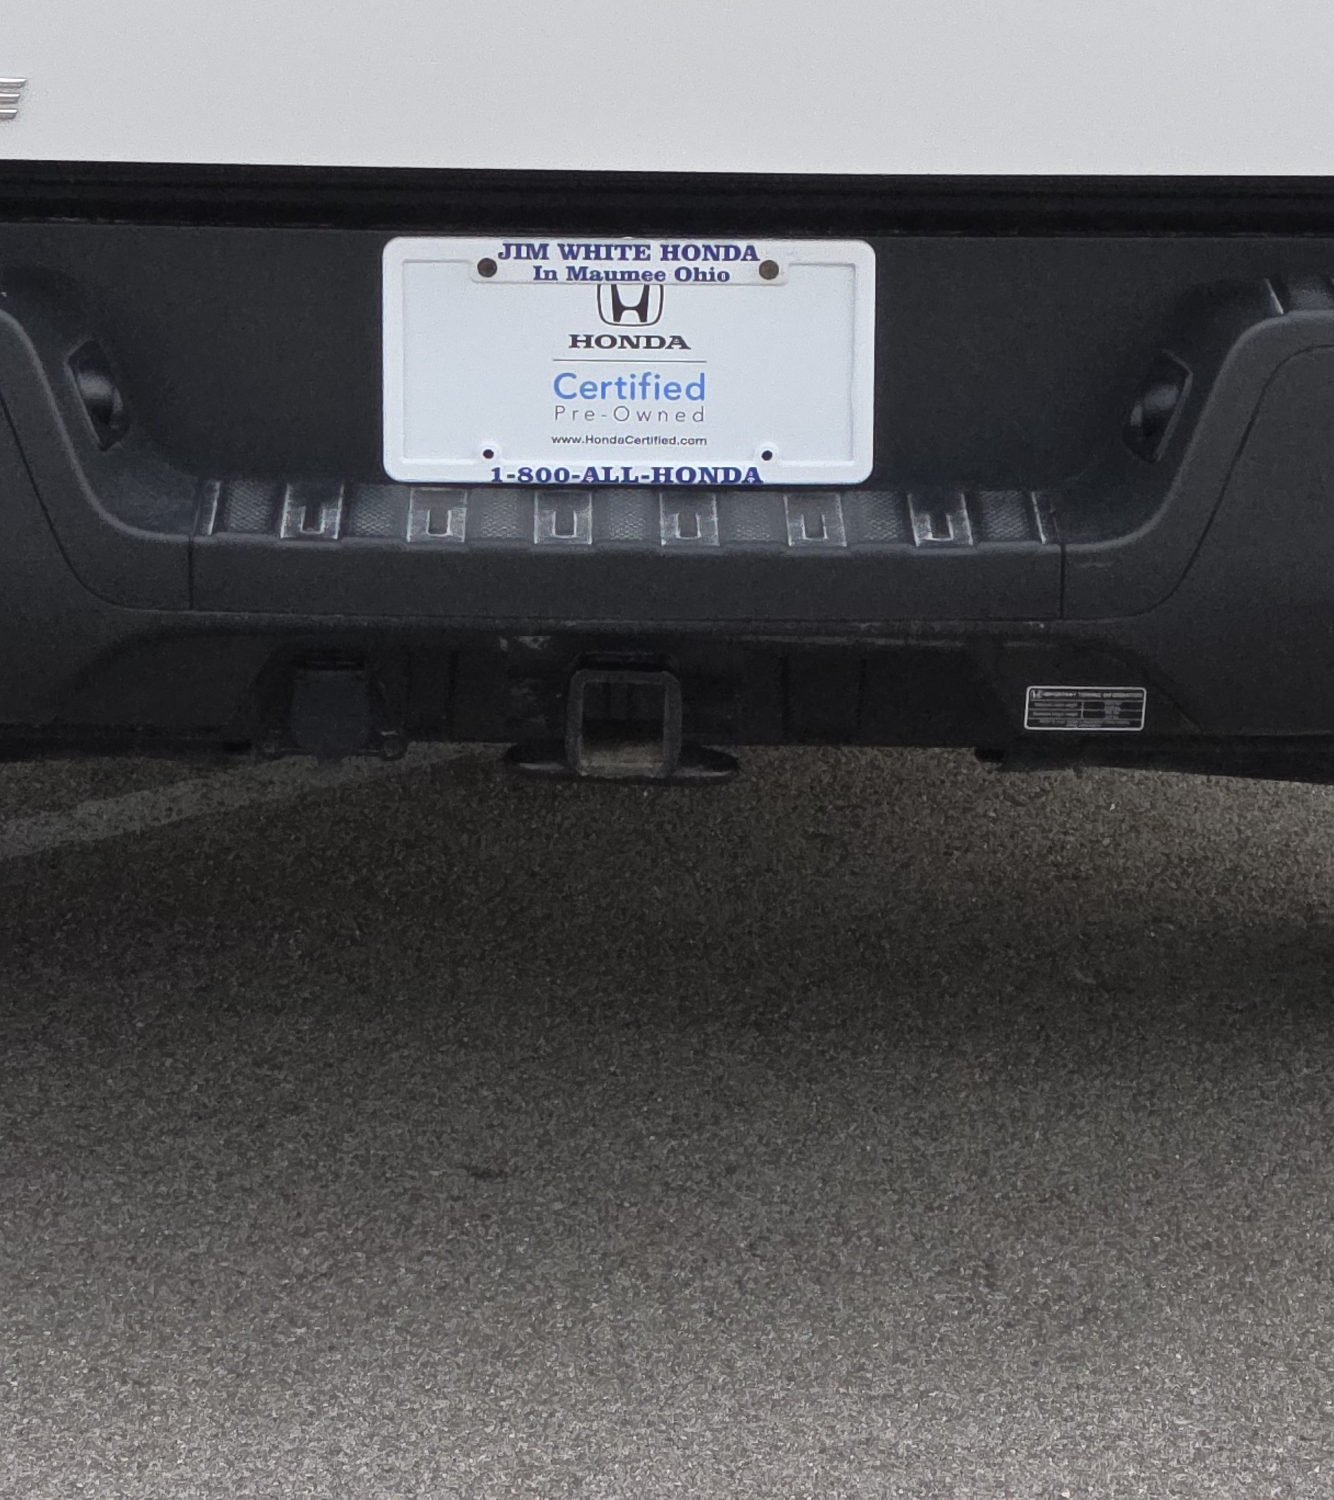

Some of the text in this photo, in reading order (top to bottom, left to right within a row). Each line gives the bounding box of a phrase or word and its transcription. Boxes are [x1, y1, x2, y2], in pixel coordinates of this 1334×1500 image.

[497, 242, 761, 263] JIM WHITE HONDA
[532, 265, 731, 283] In Maumee Ohio
[568, 333, 692, 350] HONDA
[553, 371, 706, 401] Certified
[554, 405, 705, 423] Pre-Owned
[551, 434, 707, 446] www.HondaCertified.com
[490, 465, 763, 484] 1-800-ALL-HONDA
